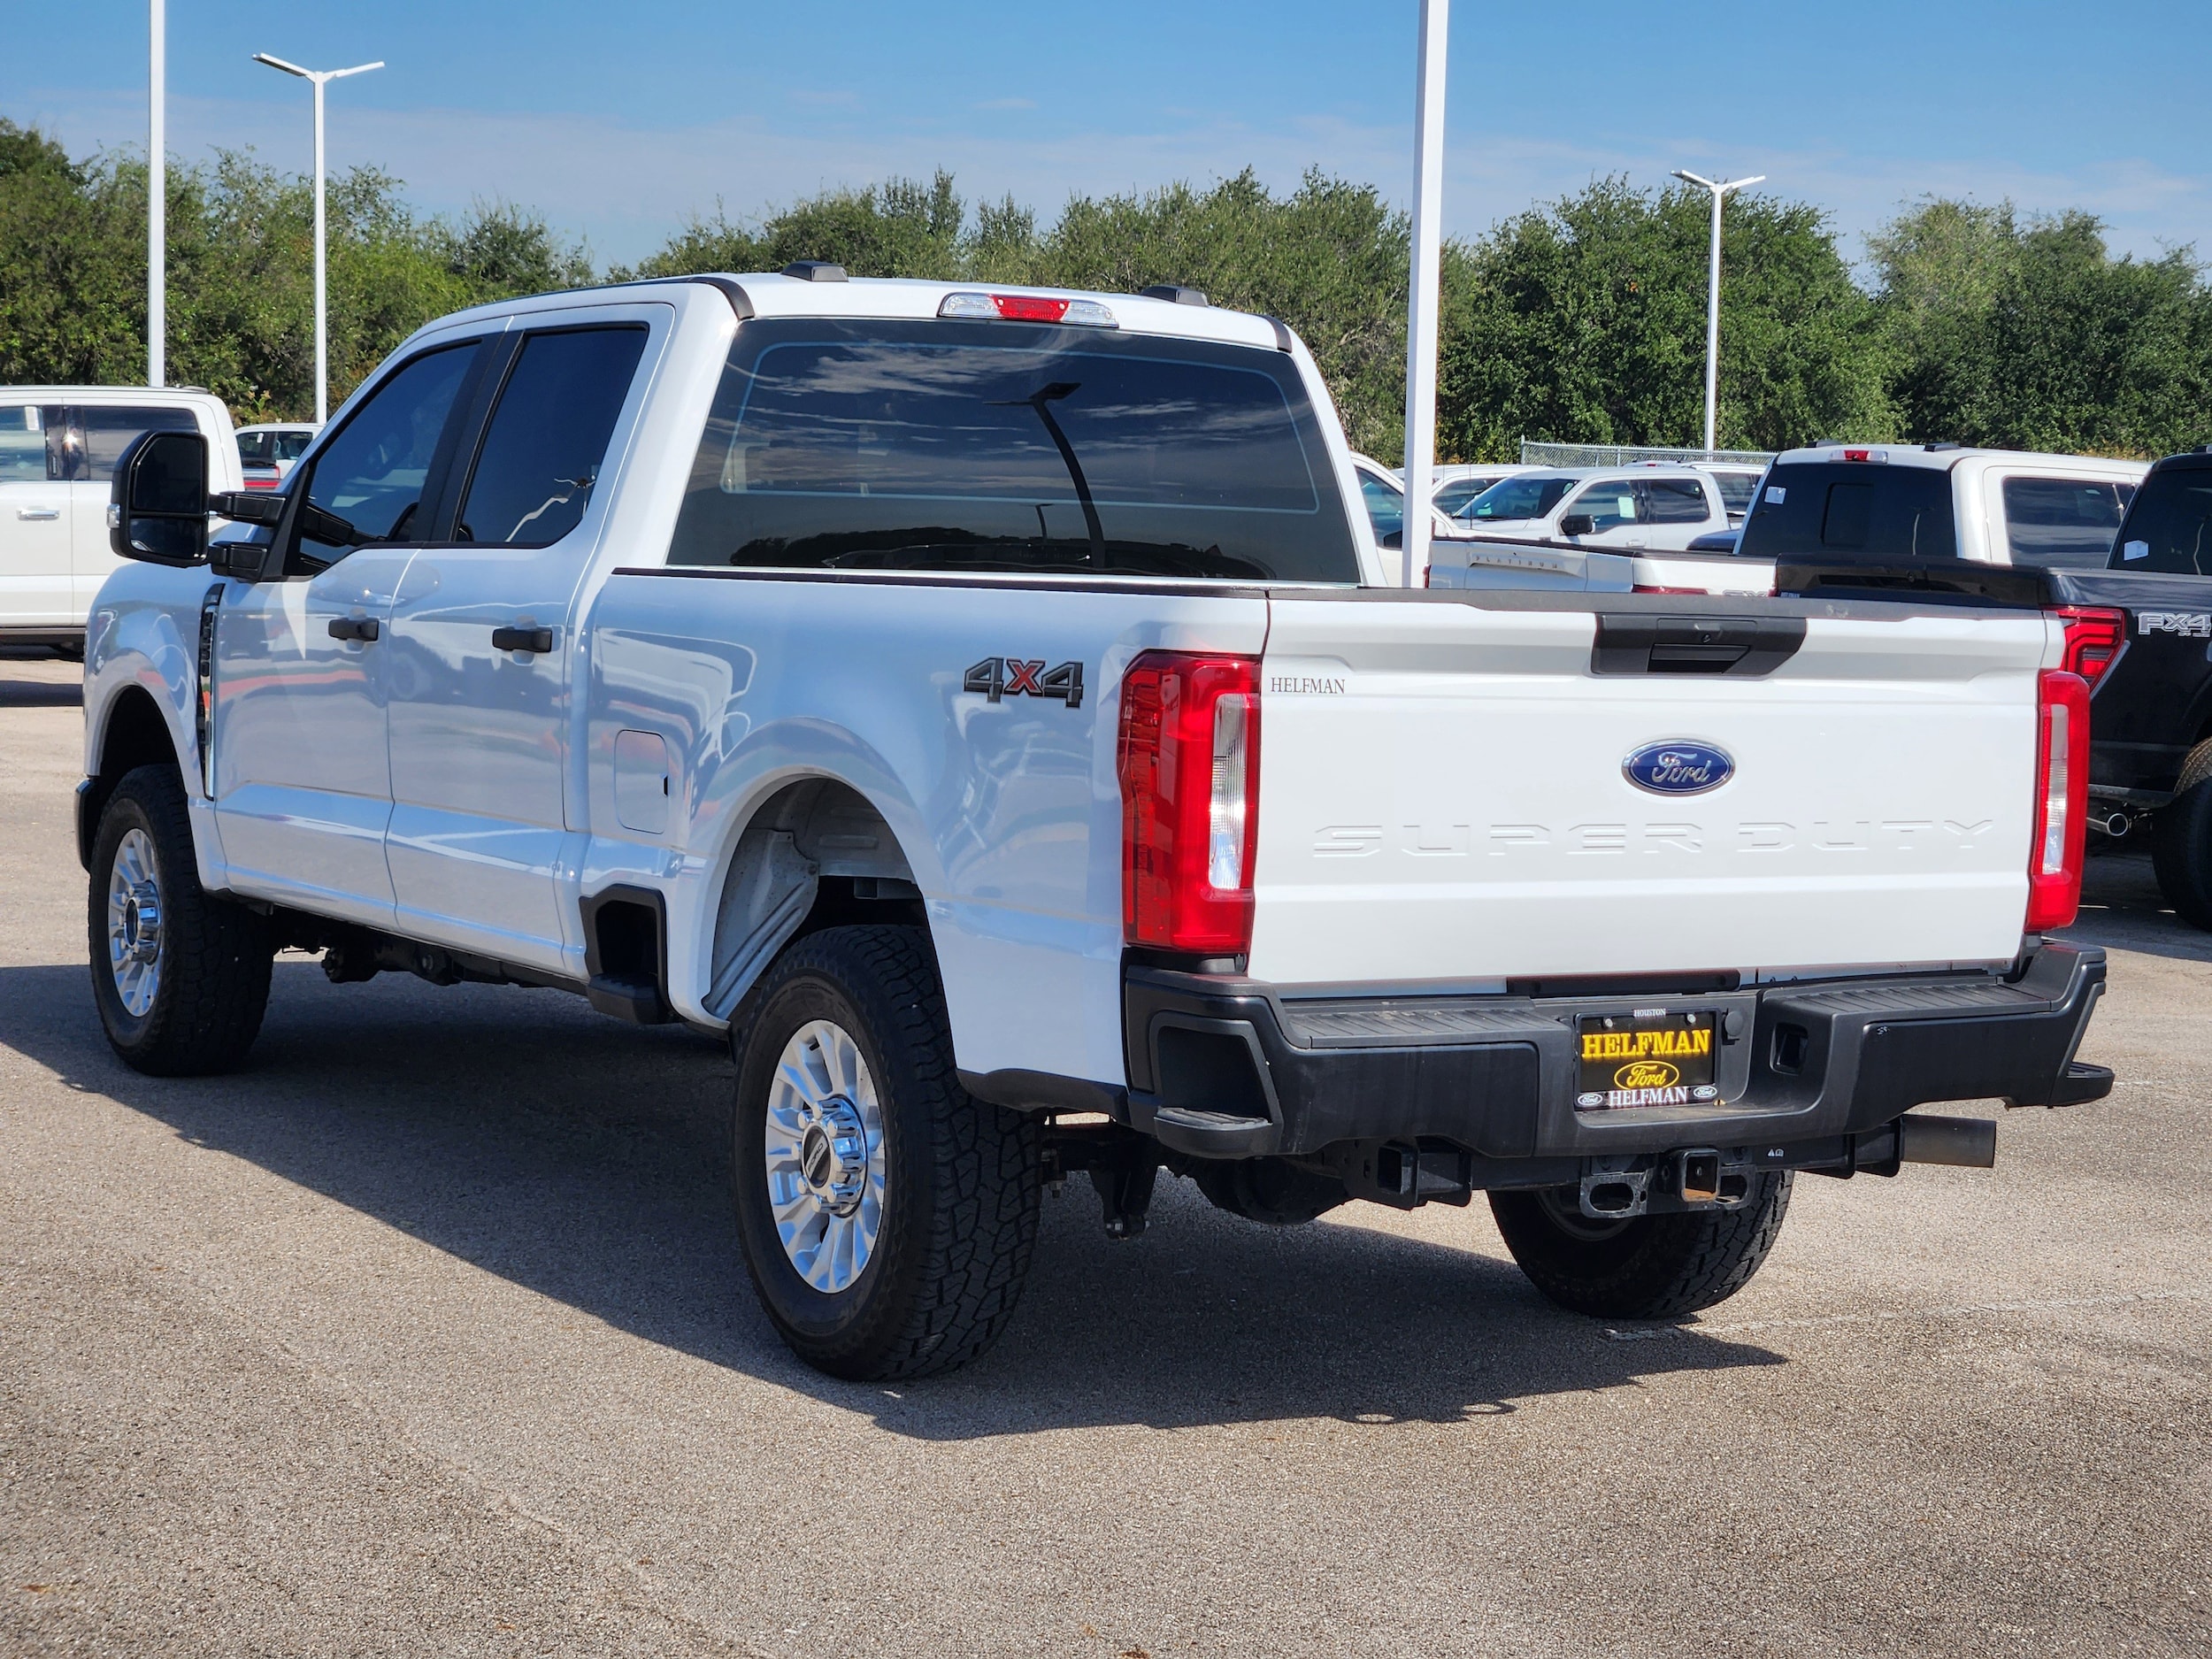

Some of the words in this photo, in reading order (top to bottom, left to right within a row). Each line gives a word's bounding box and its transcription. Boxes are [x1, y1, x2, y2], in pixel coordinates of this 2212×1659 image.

[1475, 555, 1557, 569] PLATINUM
[2138, 611, 2211, 635] FX4
[1271, 677, 1346, 695] HELFMAN
[1651, 750, 1712, 783] Ford
[1313, 823, 1703, 857] SUPER
[1737, 819, 1993, 852] DUTY
[1582, 1030, 1710, 1057] HELFMAN
[1626, 1064, 1666, 1087] Ford
[1609, 1087, 1688, 1107] HELFMAN
